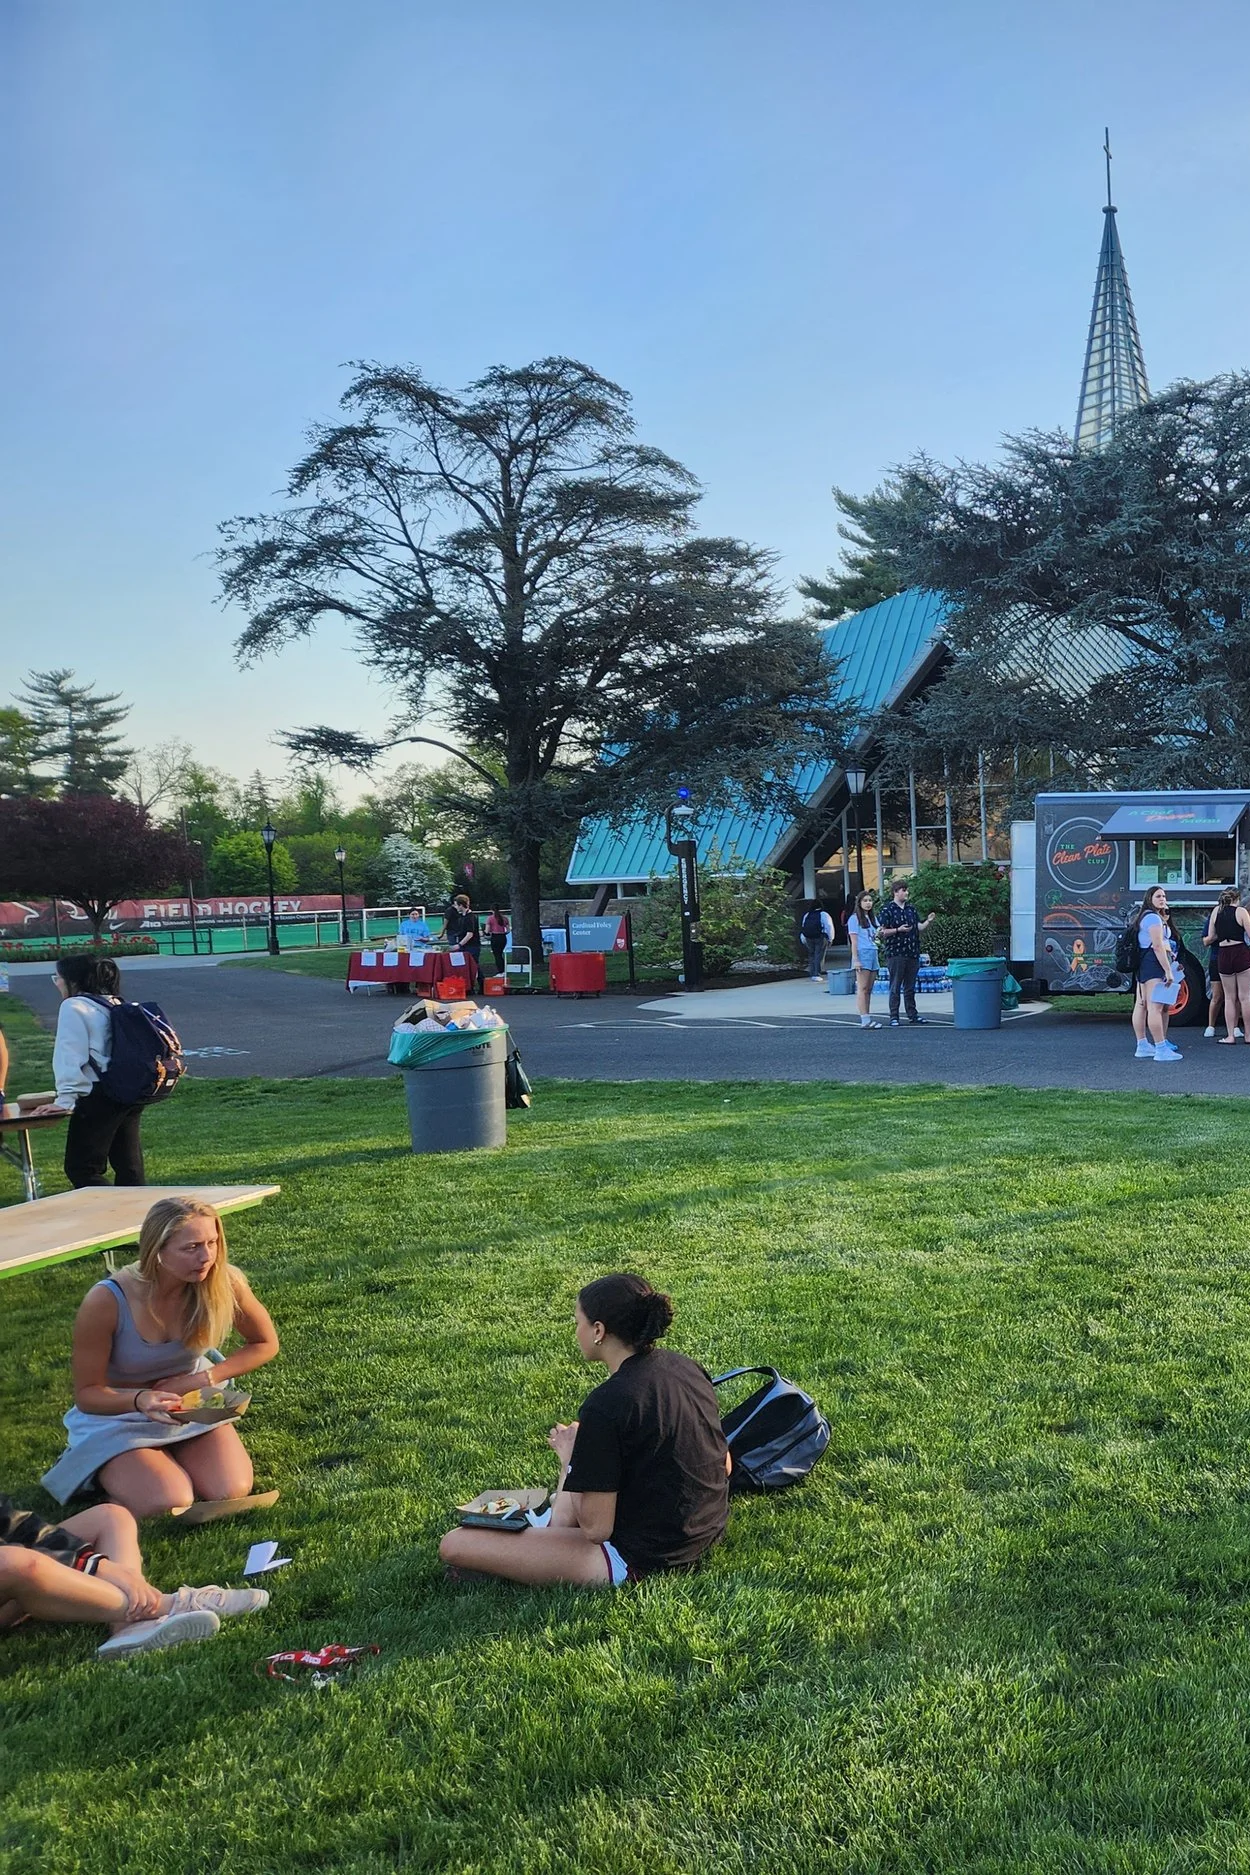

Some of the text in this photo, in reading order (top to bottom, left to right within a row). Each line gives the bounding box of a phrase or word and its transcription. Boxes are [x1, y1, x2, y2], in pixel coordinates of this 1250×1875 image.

[1052, 843, 1112, 866] Clean Plate
[681, 857, 689, 905] EMERGENCY
[144, 900, 302, 918] FIELD HOCKEY
